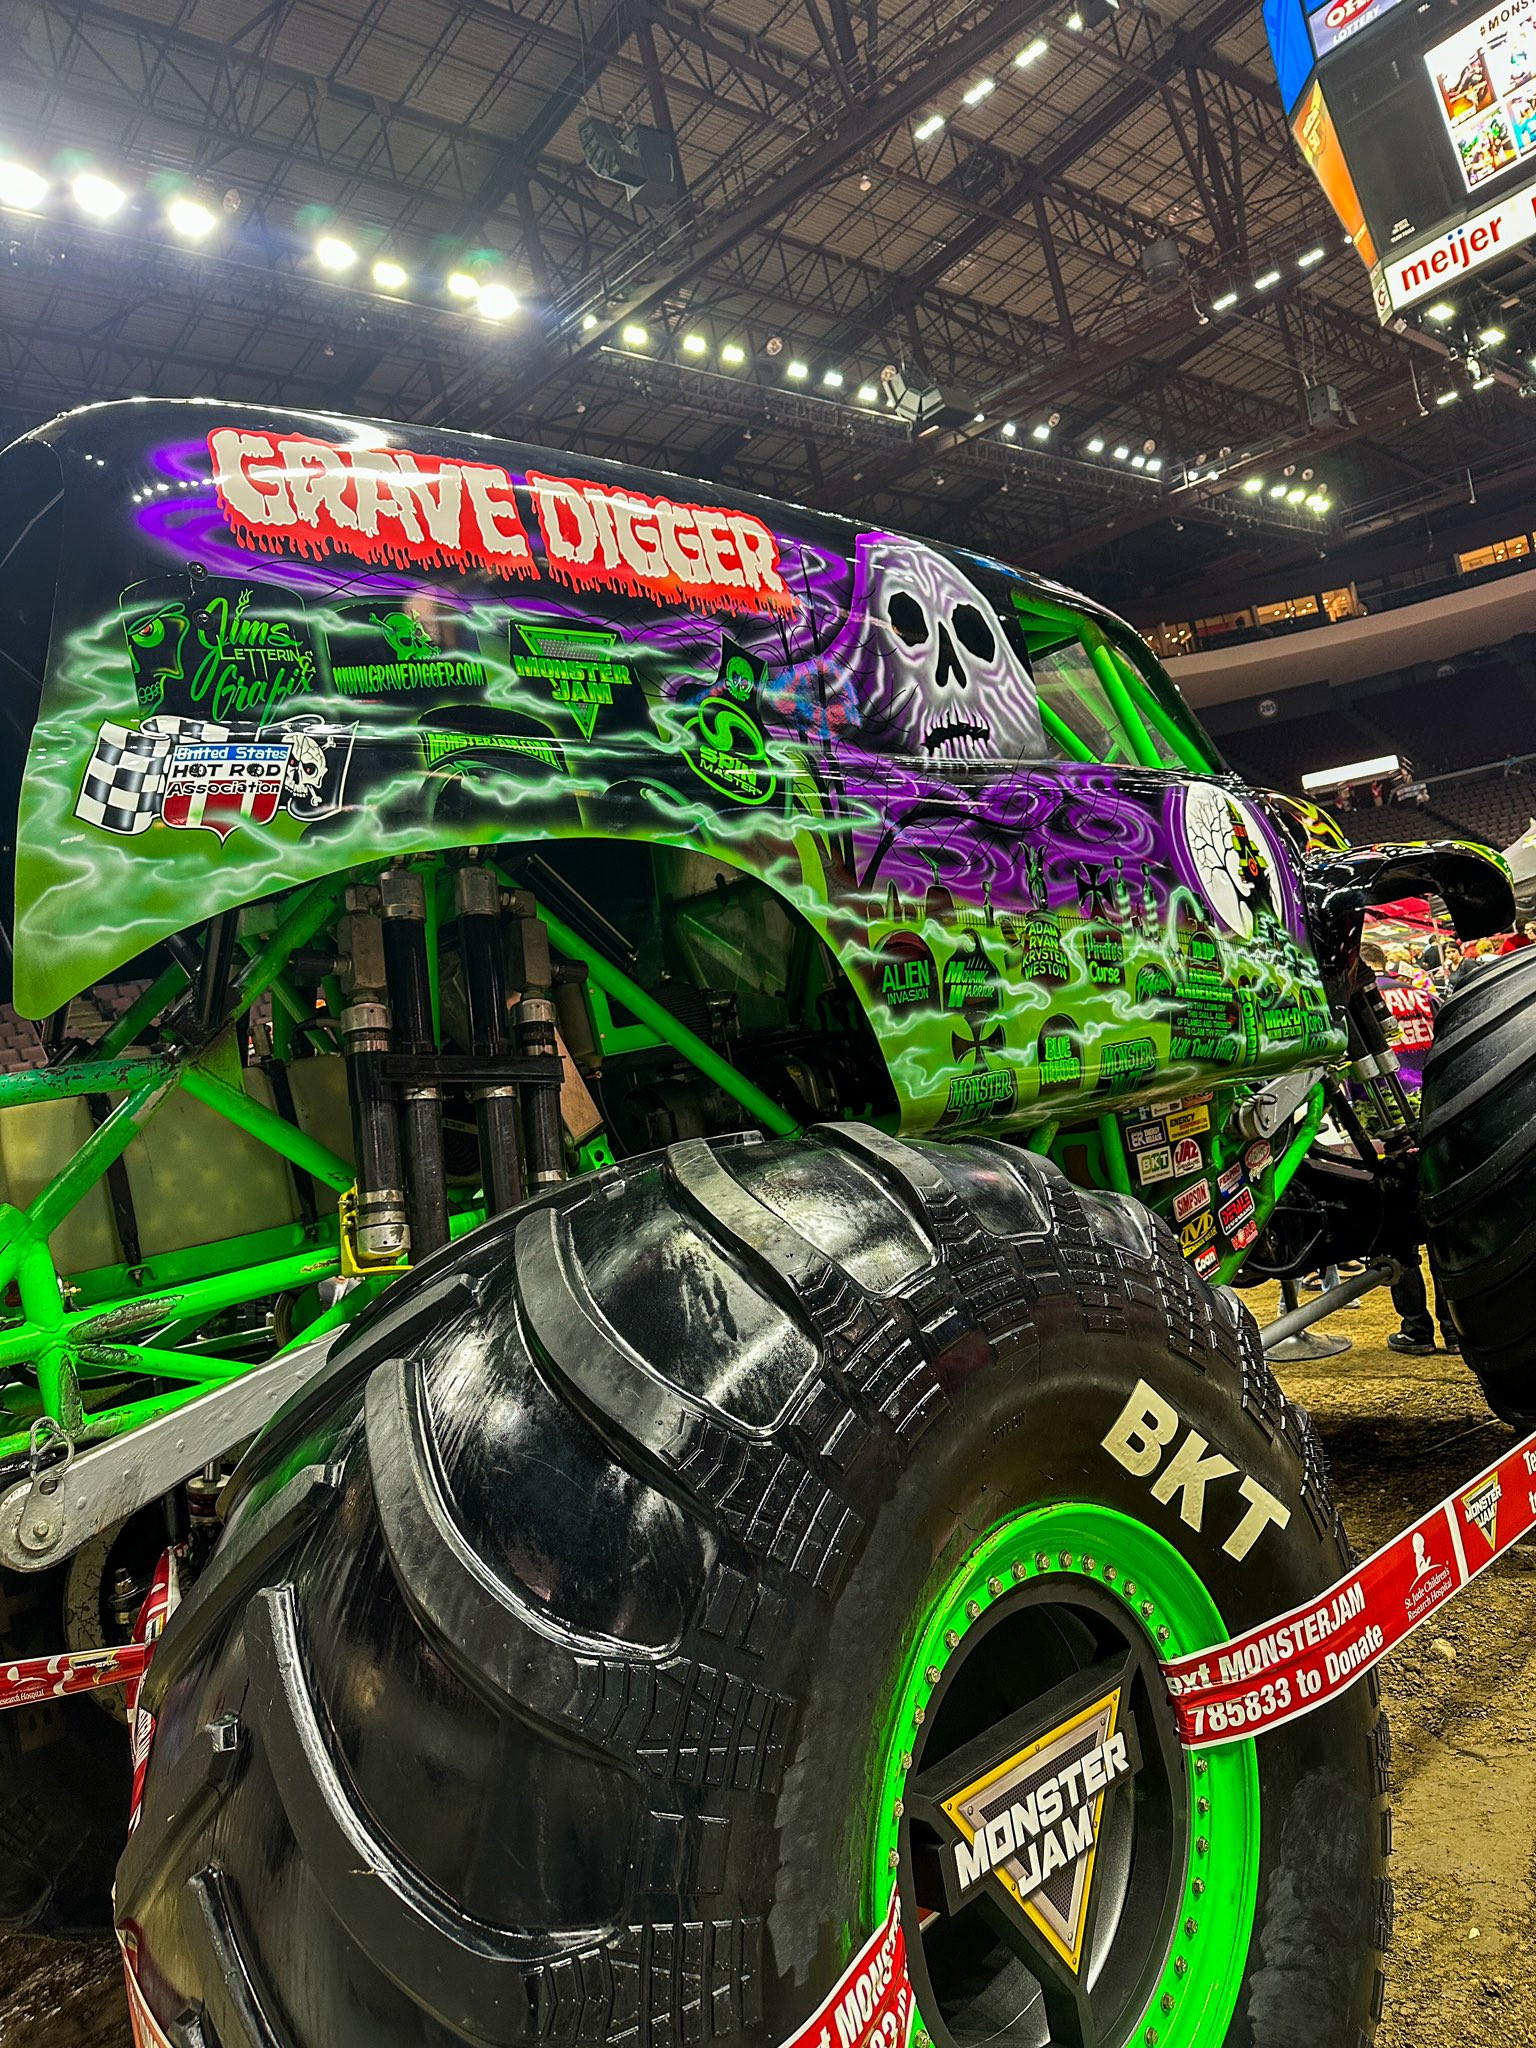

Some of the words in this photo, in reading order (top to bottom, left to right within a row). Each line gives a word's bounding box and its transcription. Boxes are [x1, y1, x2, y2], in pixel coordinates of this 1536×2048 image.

[1327, 0, 1371, 27] OH
[1333, 5, 1380, 45] LOTTERY
[1480, 0, 1536, 36] #MONS
[1401, 217, 1502, 291] meijer
[211, 429, 528, 558] GRAVE
[531, 476, 785, 594] DIGGER
[332, 661, 485, 695] WWW.GRAVEDIGGER.COM
[513, 655, 632, 685] MONSTER
[212, 662, 314, 727] Grafix
[552, 679, 613, 705] JAM
[235, 747, 288, 760] States
[427, 733, 558, 767] MONSTERJAM.COM
[172, 763, 223, 778] HOT
[229, 763, 281, 778] ROD
[700, 744, 757, 786] SPIN
[166, 781, 281, 797] Association
[1028, 921, 1059, 938] ADAM
[1029, 935, 1059, 950] RYAN
[1022, 948, 1068, 968] KRYSTEN
[1191, 940, 1216, 960] RIP
[882, 959, 931, 993] ALIEN
[1024, 960, 1068, 980] WESTON
[1088, 960, 1121, 984] Curse
[887, 987, 929, 1006] INVASION
[1381, 988, 1431, 1013] AVE
[1239, 988, 1258, 1067] ZOMBIE
[1263, 1007, 1301, 1029] MAX-D
[1044, 1036, 1072, 1061] BLUE
[1102, 1041, 1155, 1077] MONSTER
[1039, 1057, 1081, 1085] THUNDER
[951, 1071, 1012, 1108] MONSTER
[1169, 1113, 1195, 1127] ENERGY
[1141, 1150, 1170, 1174] BKT
[1175, 1140, 1199, 1164] JAZ
[1176, 1183, 1207, 1218] SIMPSON
[1194, 1251, 1217, 1273] Coan
[1100, 1378, 1291, 1562] BKT
[1522, 1449, 1536, 1475] Te
[1464, 1484, 1502, 1523] MONSTER
[1478, 1507, 1496, 1529] JAM
[1407, 1596, 1432, 1622] Research
[1430, 1577, 1452, 1604] Hospital
[1411, 1586, 1425, 1612] Jude
[1423, 1567, 1450, 1594] Children's
[1162, 1663, 1212, 1696] ext
[1218, 1581, 1366, 1683] MONSTERJAM
[1187, 1677, 1292, 1737] 785833
[1296, 1668, 1322, 1699] to
[1324, 1623, 1384, 1685] Donate
[20, 1688, 45, 1701] Hospital
[953, 1732, 1129, 1891] MONSTER
[1017, 1809, 1095, 1898] JAM
